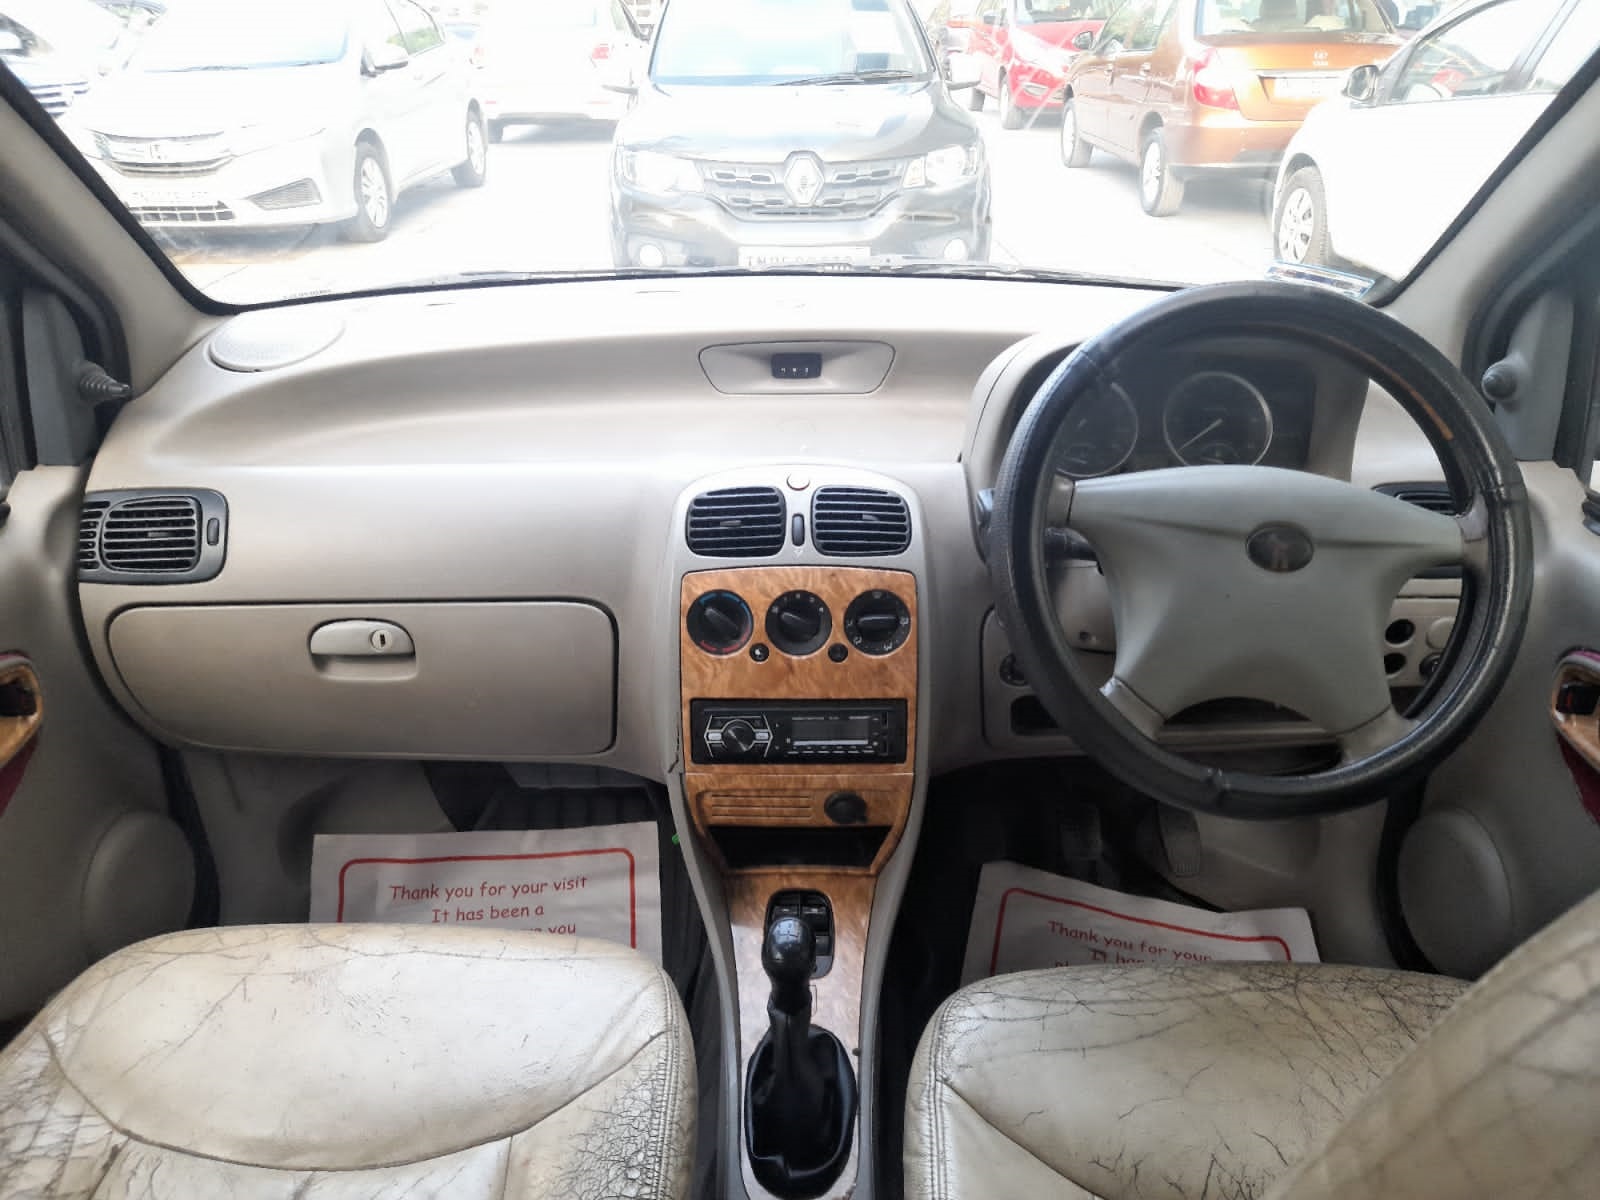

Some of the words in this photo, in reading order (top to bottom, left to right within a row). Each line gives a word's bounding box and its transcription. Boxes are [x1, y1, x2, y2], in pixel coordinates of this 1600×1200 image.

[389, 883, 439, 901] Thank
[445, 887, 474, 902] you
[480, 881, 507, 897] for
[512, 882, 548, 898] your
[553, 876, 589, 891] visit
[431, 909, 449, 923] It
[456, 906, 484, 921] has
[490, 904, 529, 919] been
[535, 905, 545, 916] a
[1048, 920, 1099, 943] Thank
[1104, 936, 1133, 950] you
[1140, 940, 1168, 955] for
[1173, 949, 1213, 961] your
